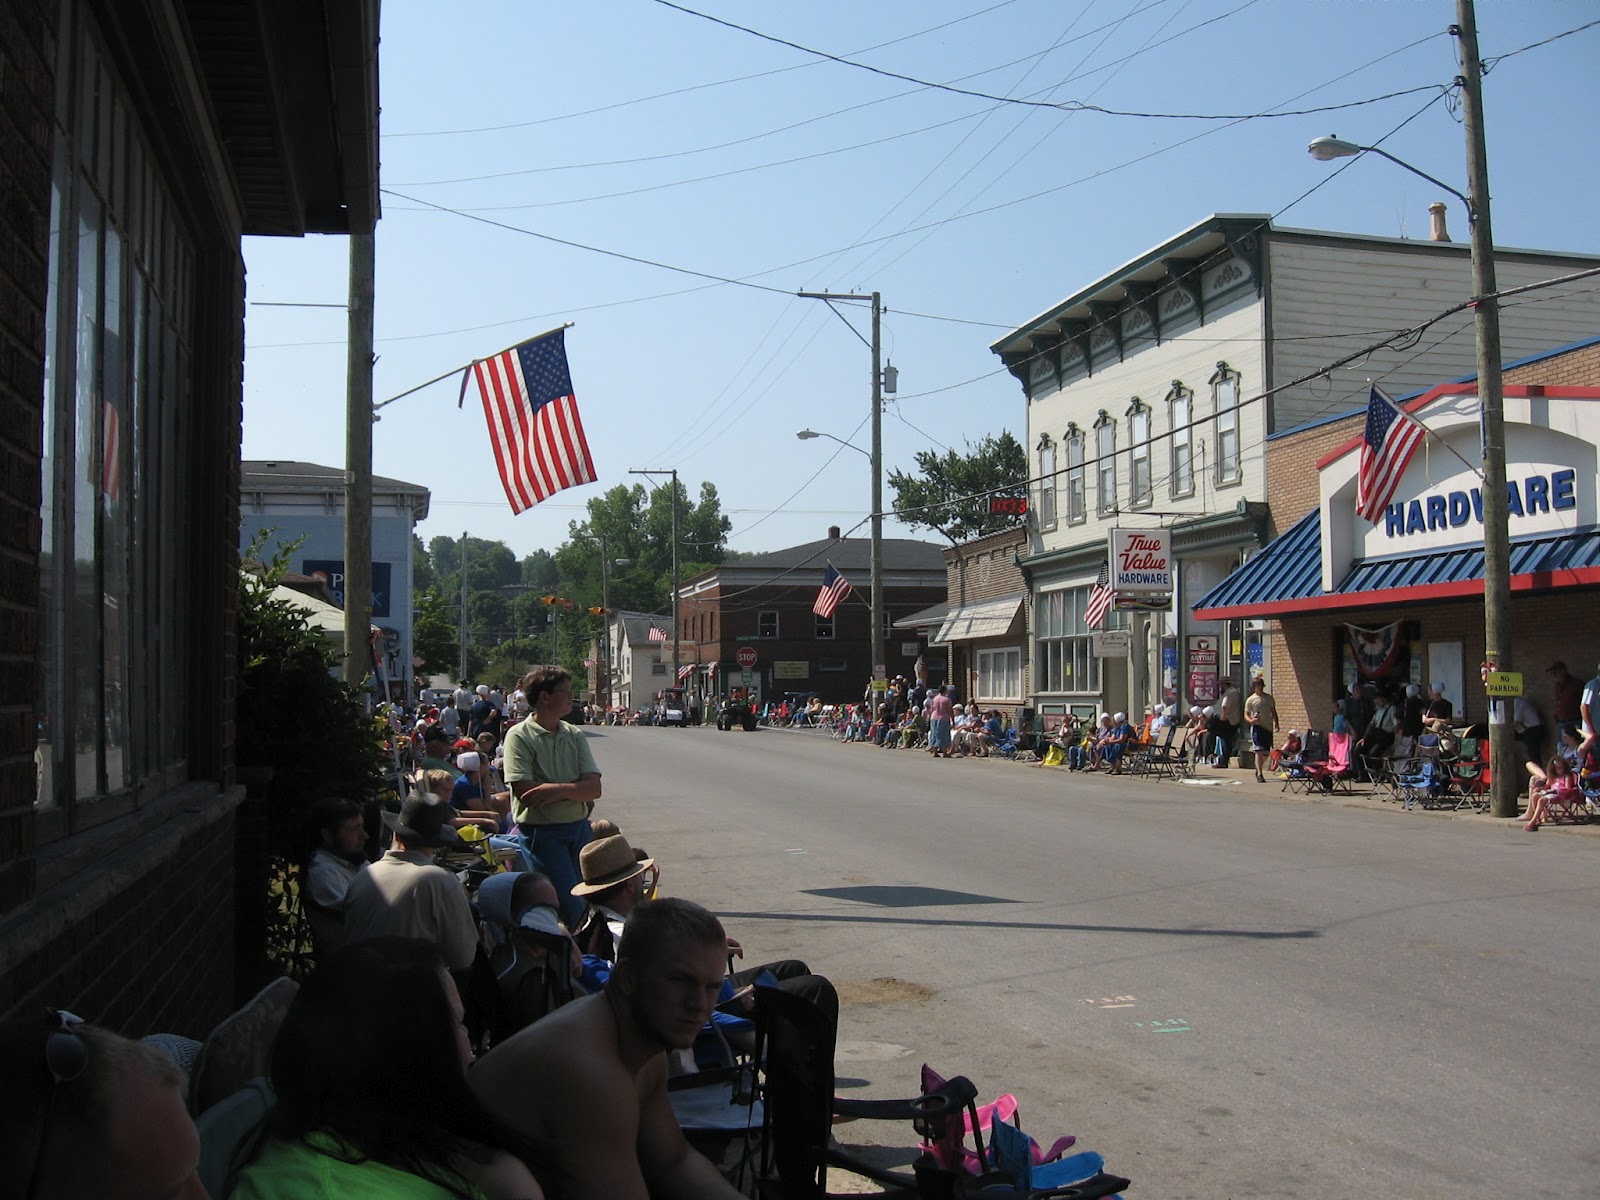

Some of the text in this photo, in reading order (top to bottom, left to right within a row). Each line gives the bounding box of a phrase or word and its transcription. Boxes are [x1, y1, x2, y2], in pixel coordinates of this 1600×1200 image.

[1125, 534, 1162, 552] True
[1119, 552, 1166, 571] Value
[1118, 573, 1169, 584] HARDWARE
[333, 590, 382, 607] BK
[738, 653, 756, 661] STOP
[1190, 654, 1216, 662] ANYTIME
[1489, 684, 1520, 692] PARKING
